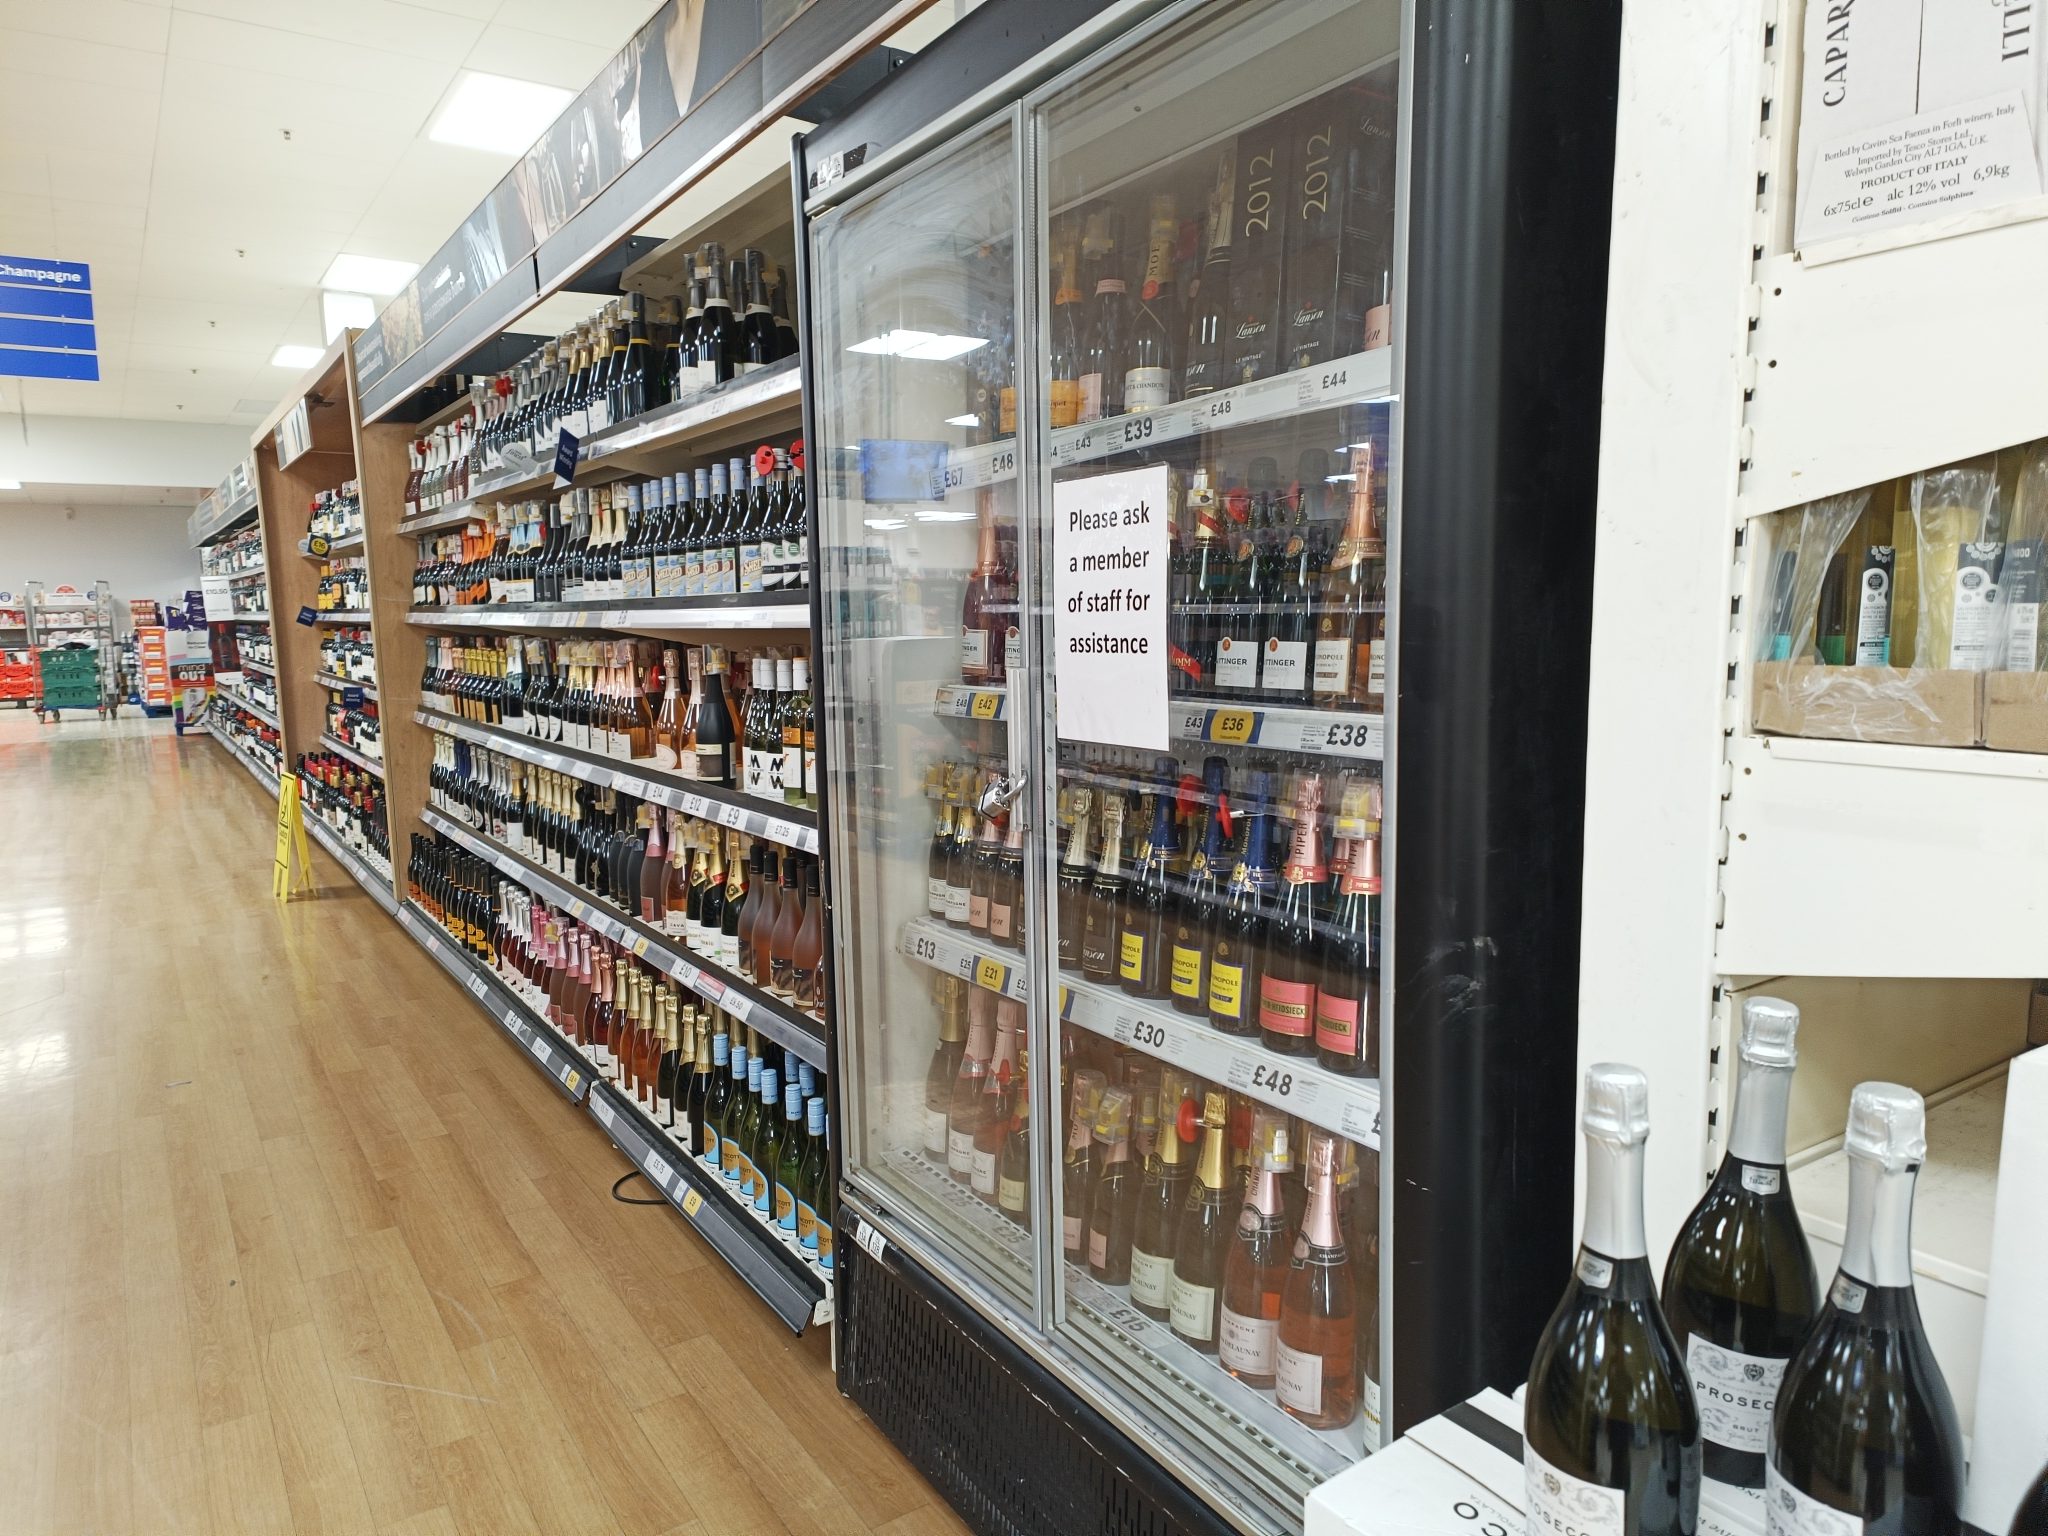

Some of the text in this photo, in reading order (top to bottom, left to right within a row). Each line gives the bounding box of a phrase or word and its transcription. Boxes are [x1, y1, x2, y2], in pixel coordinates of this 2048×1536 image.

[1824, 147, 1851, 162] Bottled
[1851, 145, 1861, 156] by
[1932, 124, 1941, 133] in
[1857, 150, 1892, 167] Imported
[1893, 146, 1902, 157] by
[1904, 142, 1926, 154] Tesco
[1927, 135, 1953, 149] Stores
[1303, 125, 1332, 220] 2012
[1844, 163, 1873, 179] Welwyn
[1873, 157, 1903, 172] Garden
[1904, 152, 1923, 166] City
[1860, 155, 1969, 190] PRODUCT OF ITALY
[1246, 147, 1274, 237] 2012
[1887, 187, 1904, 202] alc
[1908, 179, 1937, 197] 12%
[1940, 172, 1961, 189] vol
[1973, 163, 2012, 183] 6,9kg
[1322, 370, 1347, 390] £44
[1211, 400, 1232, 417] £48
[1124, 416, 1153, 443] £39
[1075, 436, 1091, 451] £43
[992, 453, 1014, 475] £48
[944, 467, 963, 488] £67
[1070, 500, 1150, 532] Please ask
[1069, 545, 1149, 573] a member
[1068, 588, 1150, 613] of staff for
[1069, 631, 1149, 655] assistance
[1221, 717, 1245, 731] £36
[1326, 723, 1368, 747] £38
[726, 807, 740, 826] £9
[1295, 821, 1308, 857] PIPER
[917, 937, 936, 960] £13
[984, 965, 998, 981] £21
[1016, 978, 1028, 992] £2
[1133, 1020, 1165, 1048] £30
[1252, 1064, 1293, 1096] £48
[1109, 1308, 1151, 1332] £15
